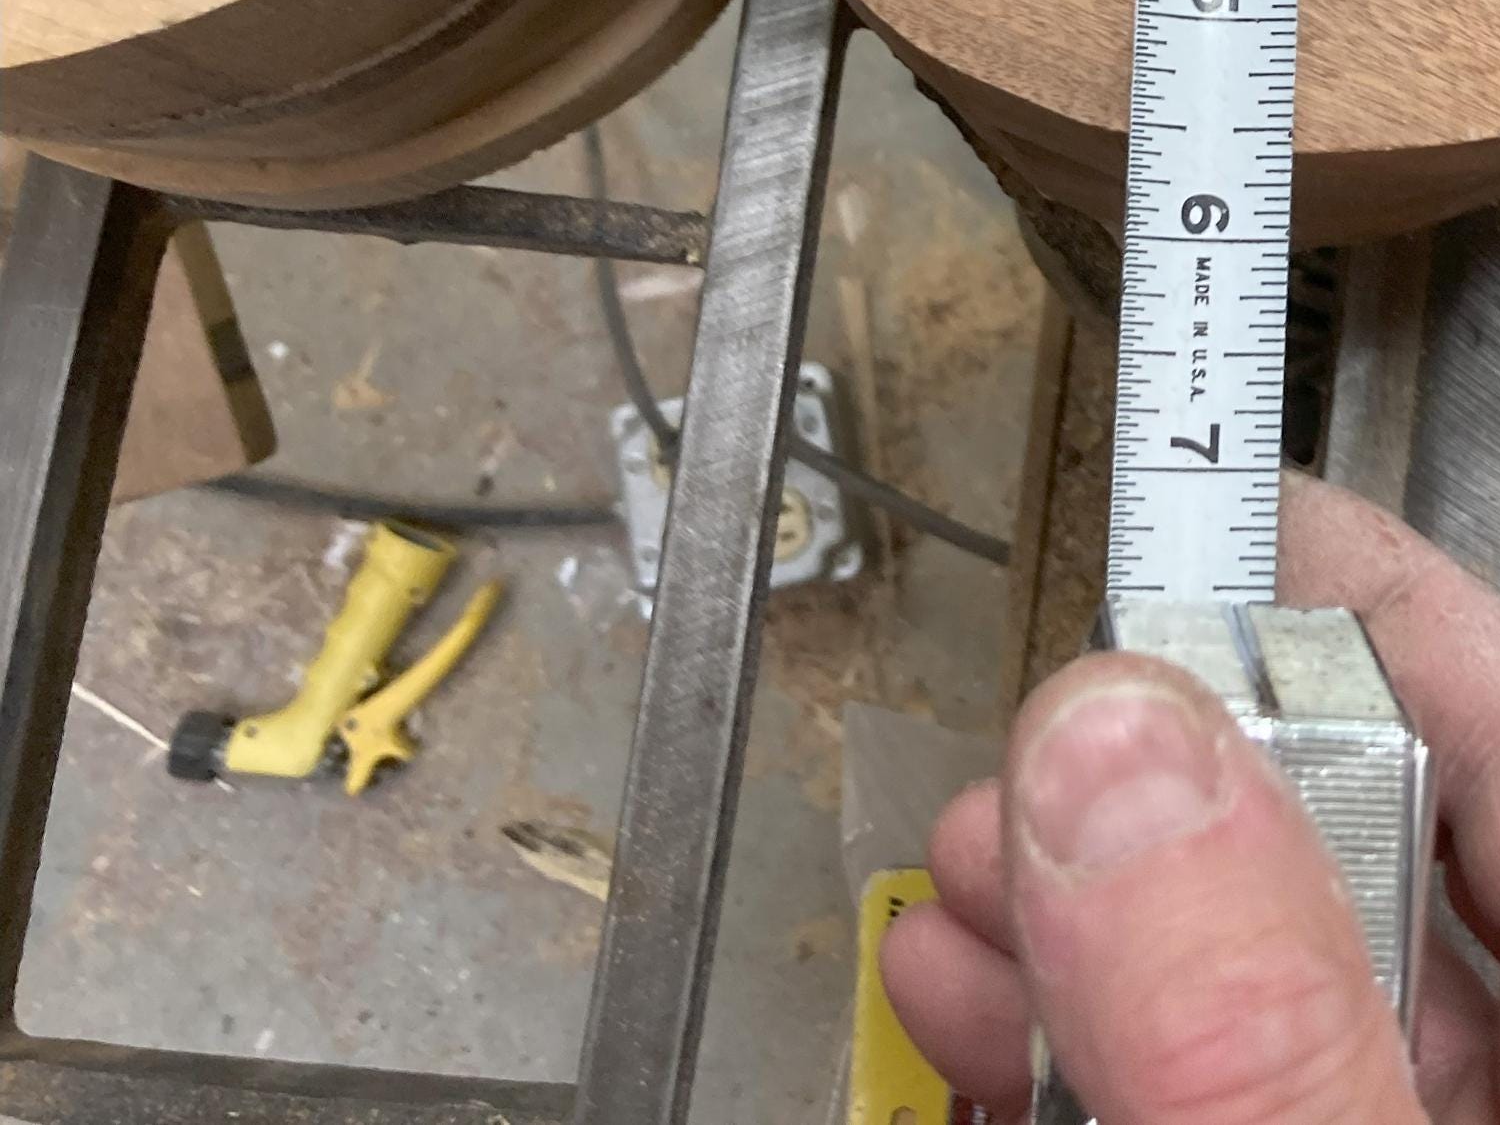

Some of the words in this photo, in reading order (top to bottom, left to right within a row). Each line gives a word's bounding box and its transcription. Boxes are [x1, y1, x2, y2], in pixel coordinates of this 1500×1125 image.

[1181, 194, 1230, 234] 6
[1194, 256, 1211, 306] MADE
[1192, 321, 1209, 338] IN
[1189, 349, 1209, 403] U.S.A.
[1170, 423, 1220, 464] 7
